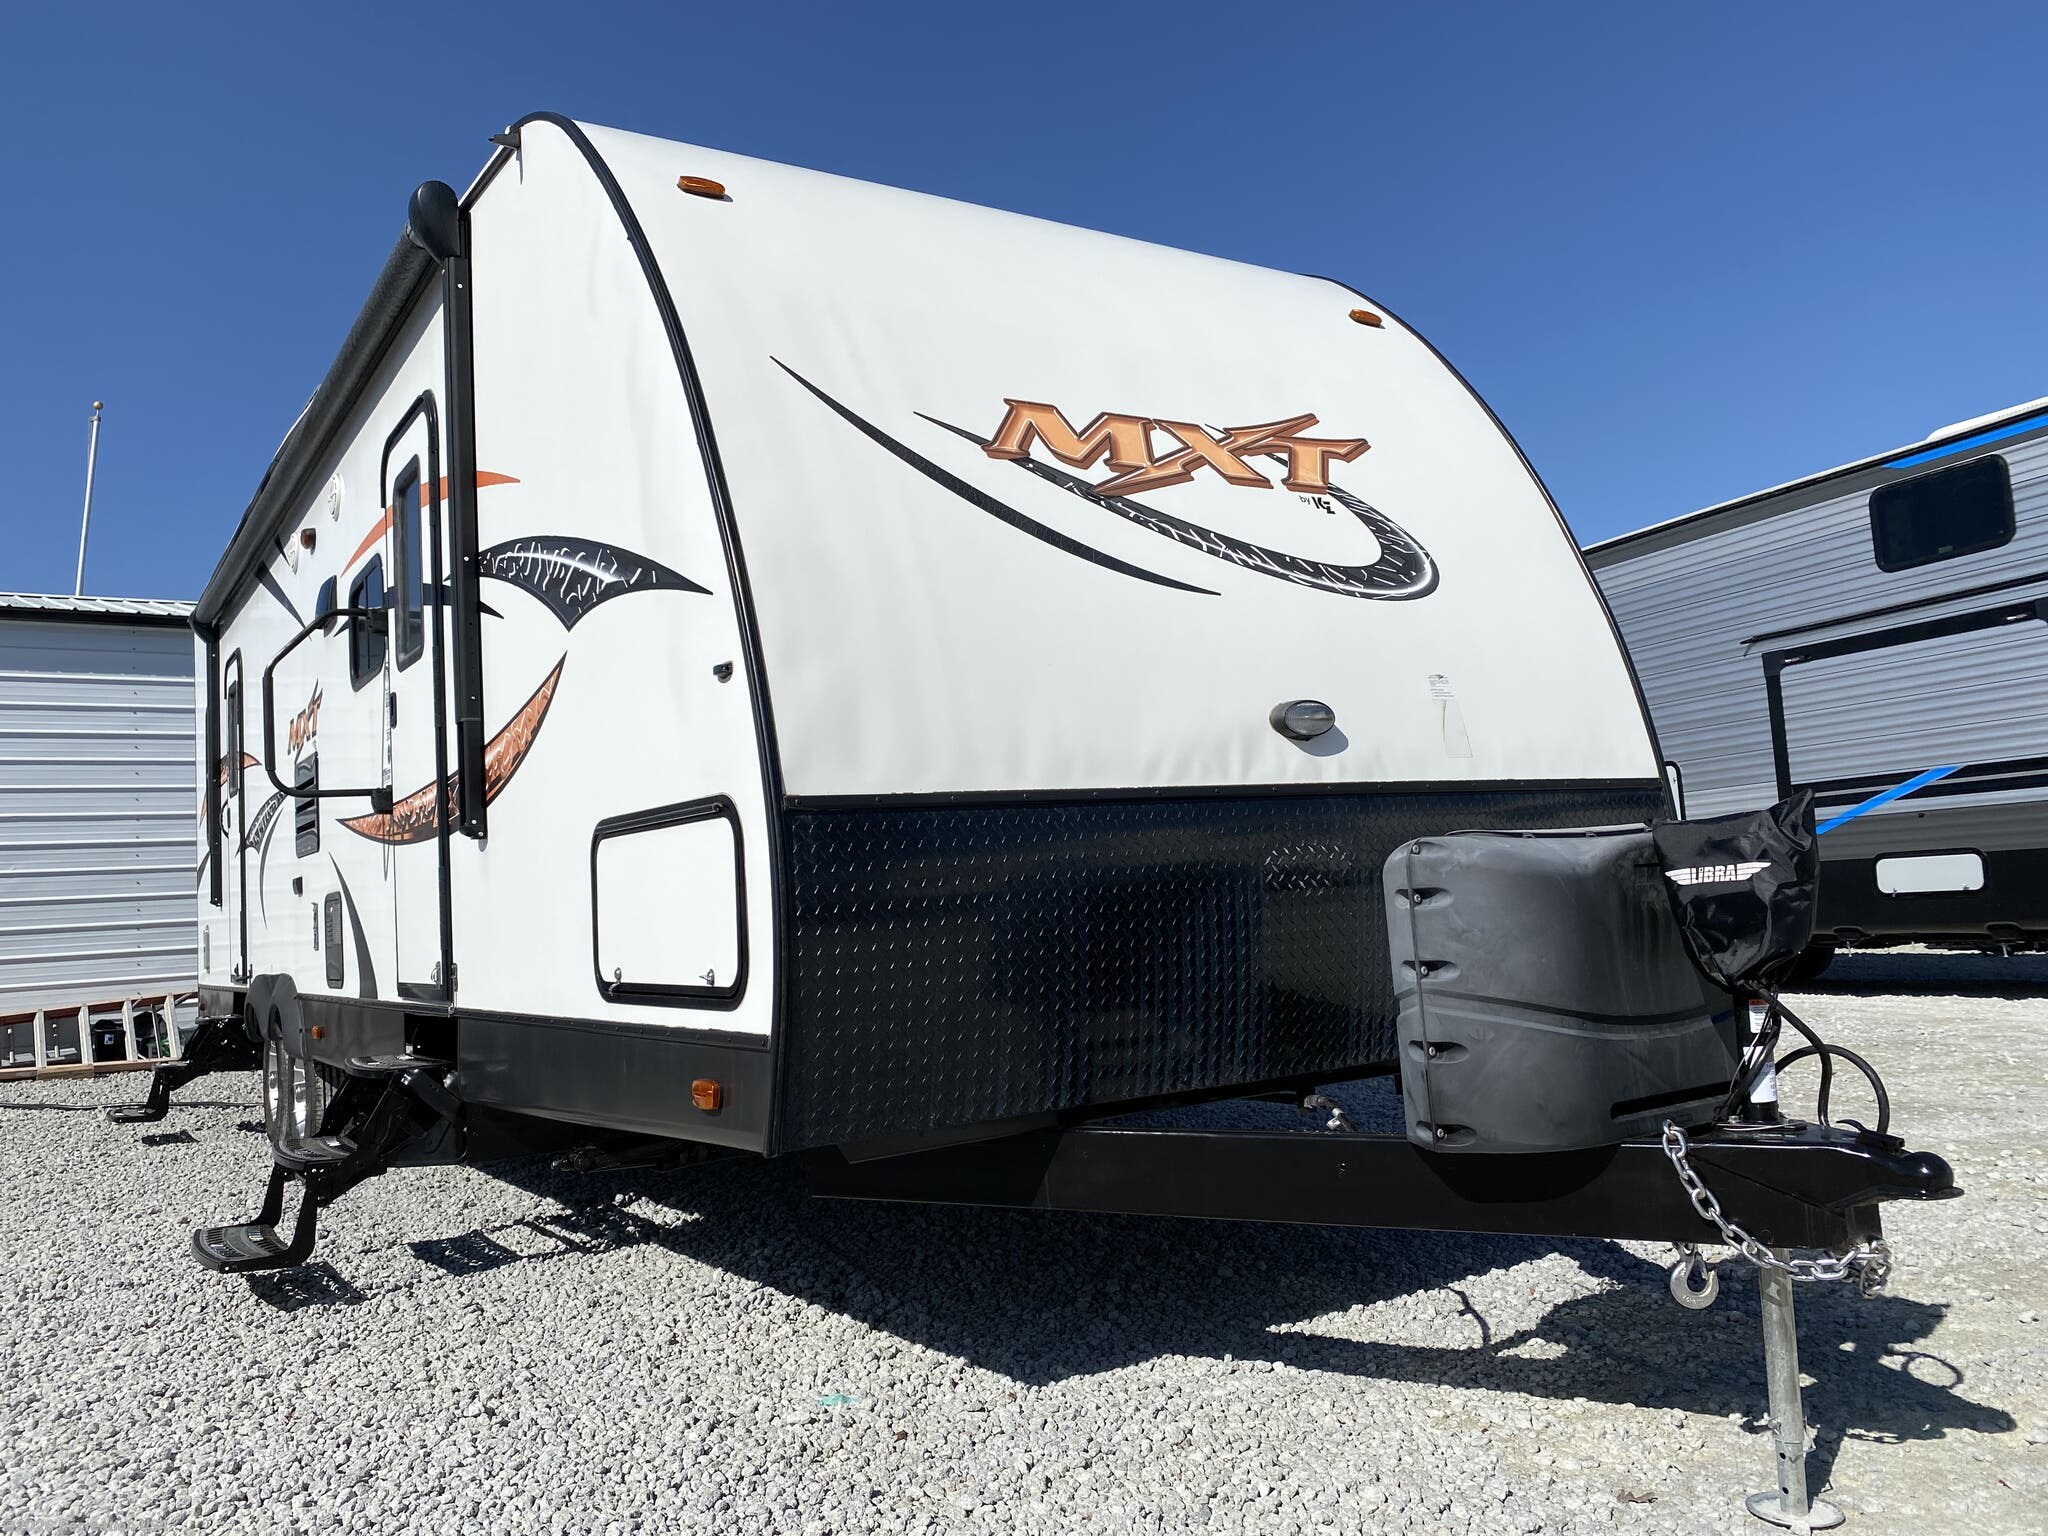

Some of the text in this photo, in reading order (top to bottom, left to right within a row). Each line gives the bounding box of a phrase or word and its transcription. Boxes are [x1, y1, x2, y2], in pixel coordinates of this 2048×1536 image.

[981, 398, 1371, 496] MXT
[1298, 495, 1311, 505] by
[287, 678, 324, 763] MXT
